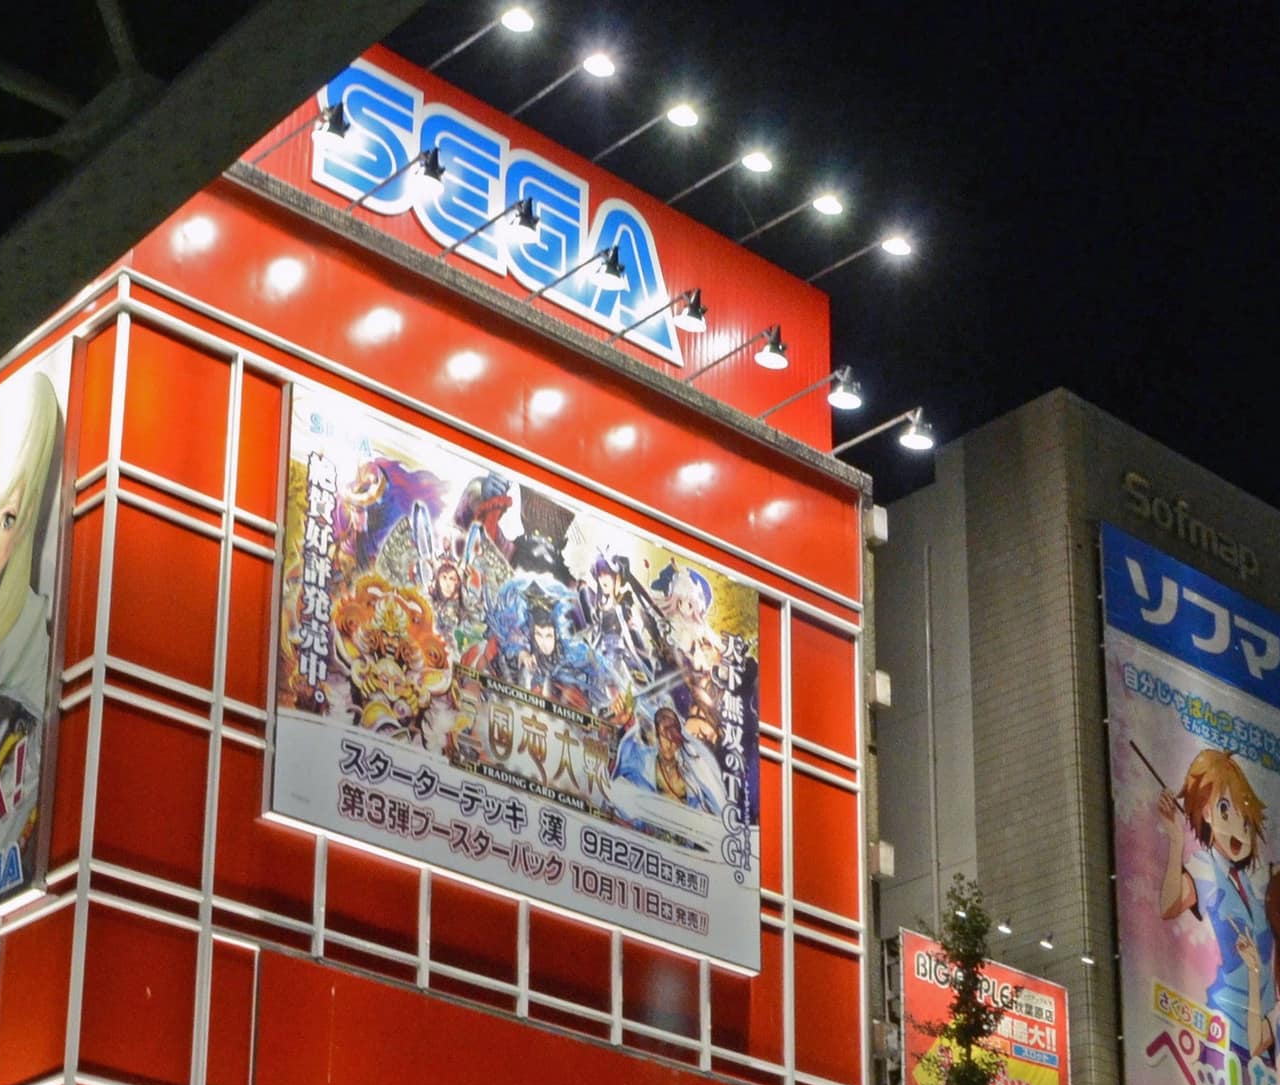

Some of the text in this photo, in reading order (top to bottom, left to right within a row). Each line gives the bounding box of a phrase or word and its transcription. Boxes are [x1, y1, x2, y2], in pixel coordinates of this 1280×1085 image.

[312, 58, 683, 367] SEGA
[1125, 472, 1258, 581] Sofmap
[486, 679, 585, 723] SANGOKUSHI TAISEN
[341, 741, 528, 832] スターターデッキ
[482, 765, 585, 810] TRADING CARD GAME
[914, 951, 1012, 1011] BIG APLE
[1158, 991, 1224, 1042] さくら荘の
